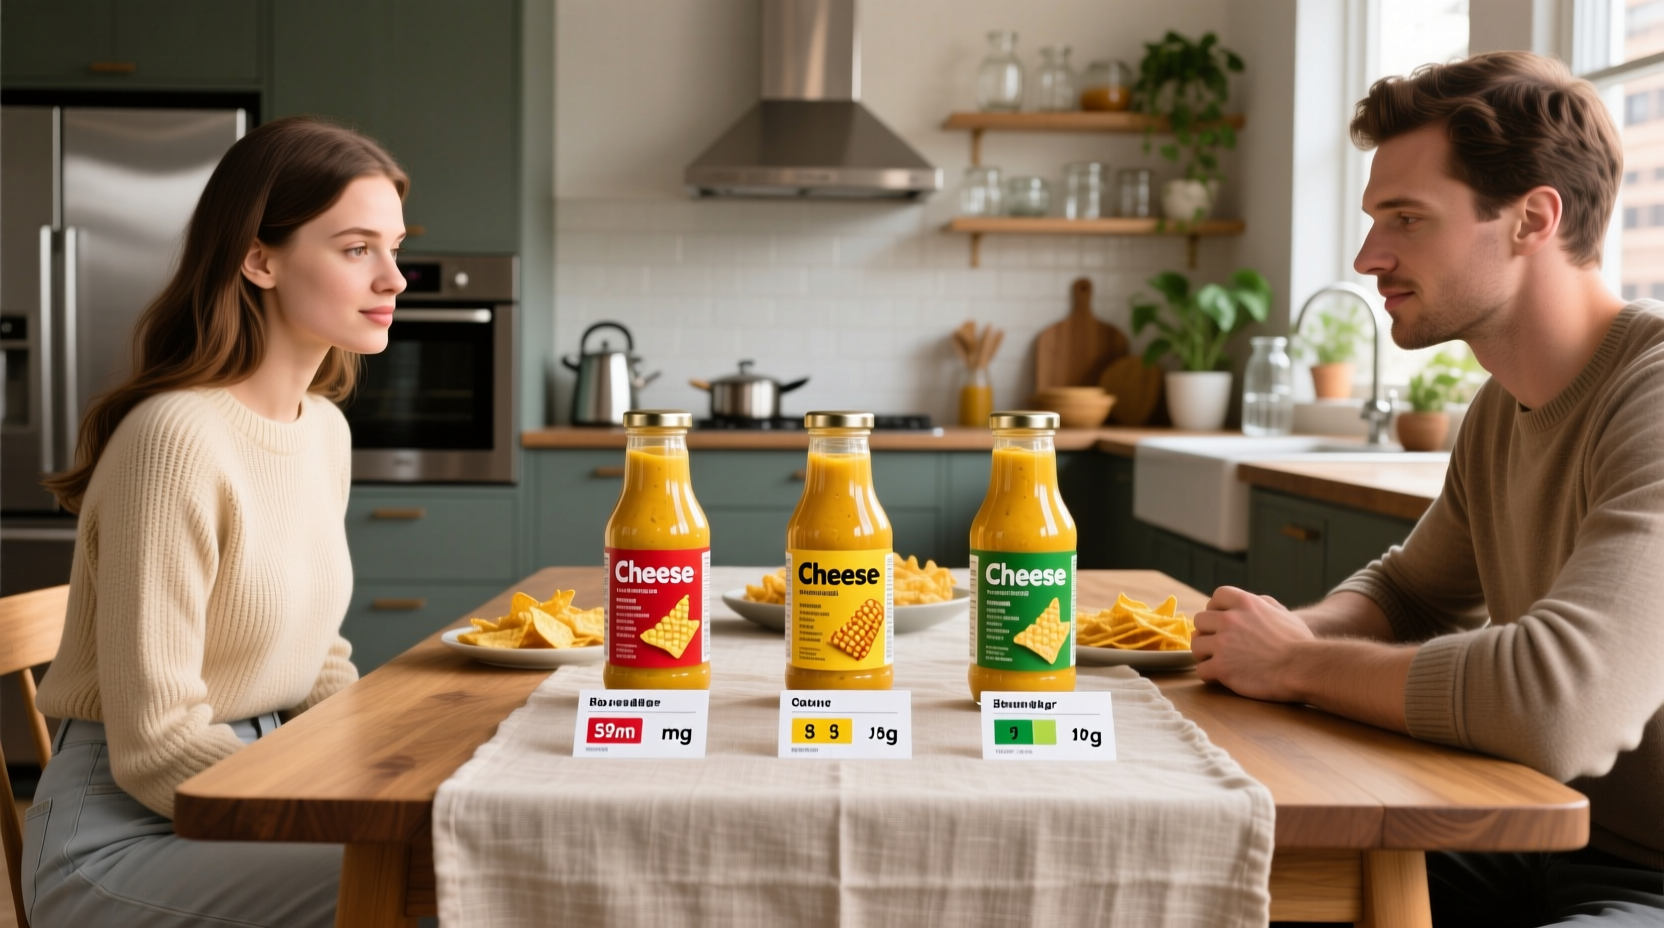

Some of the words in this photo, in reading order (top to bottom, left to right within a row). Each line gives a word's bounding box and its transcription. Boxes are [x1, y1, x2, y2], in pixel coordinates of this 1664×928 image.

[615, 559, 695, 584] Cheese
[798, 561, 880, 585] Cheese
[985, 562, 1067, 586] Cheese
[661, 727, 692, 745] mg
